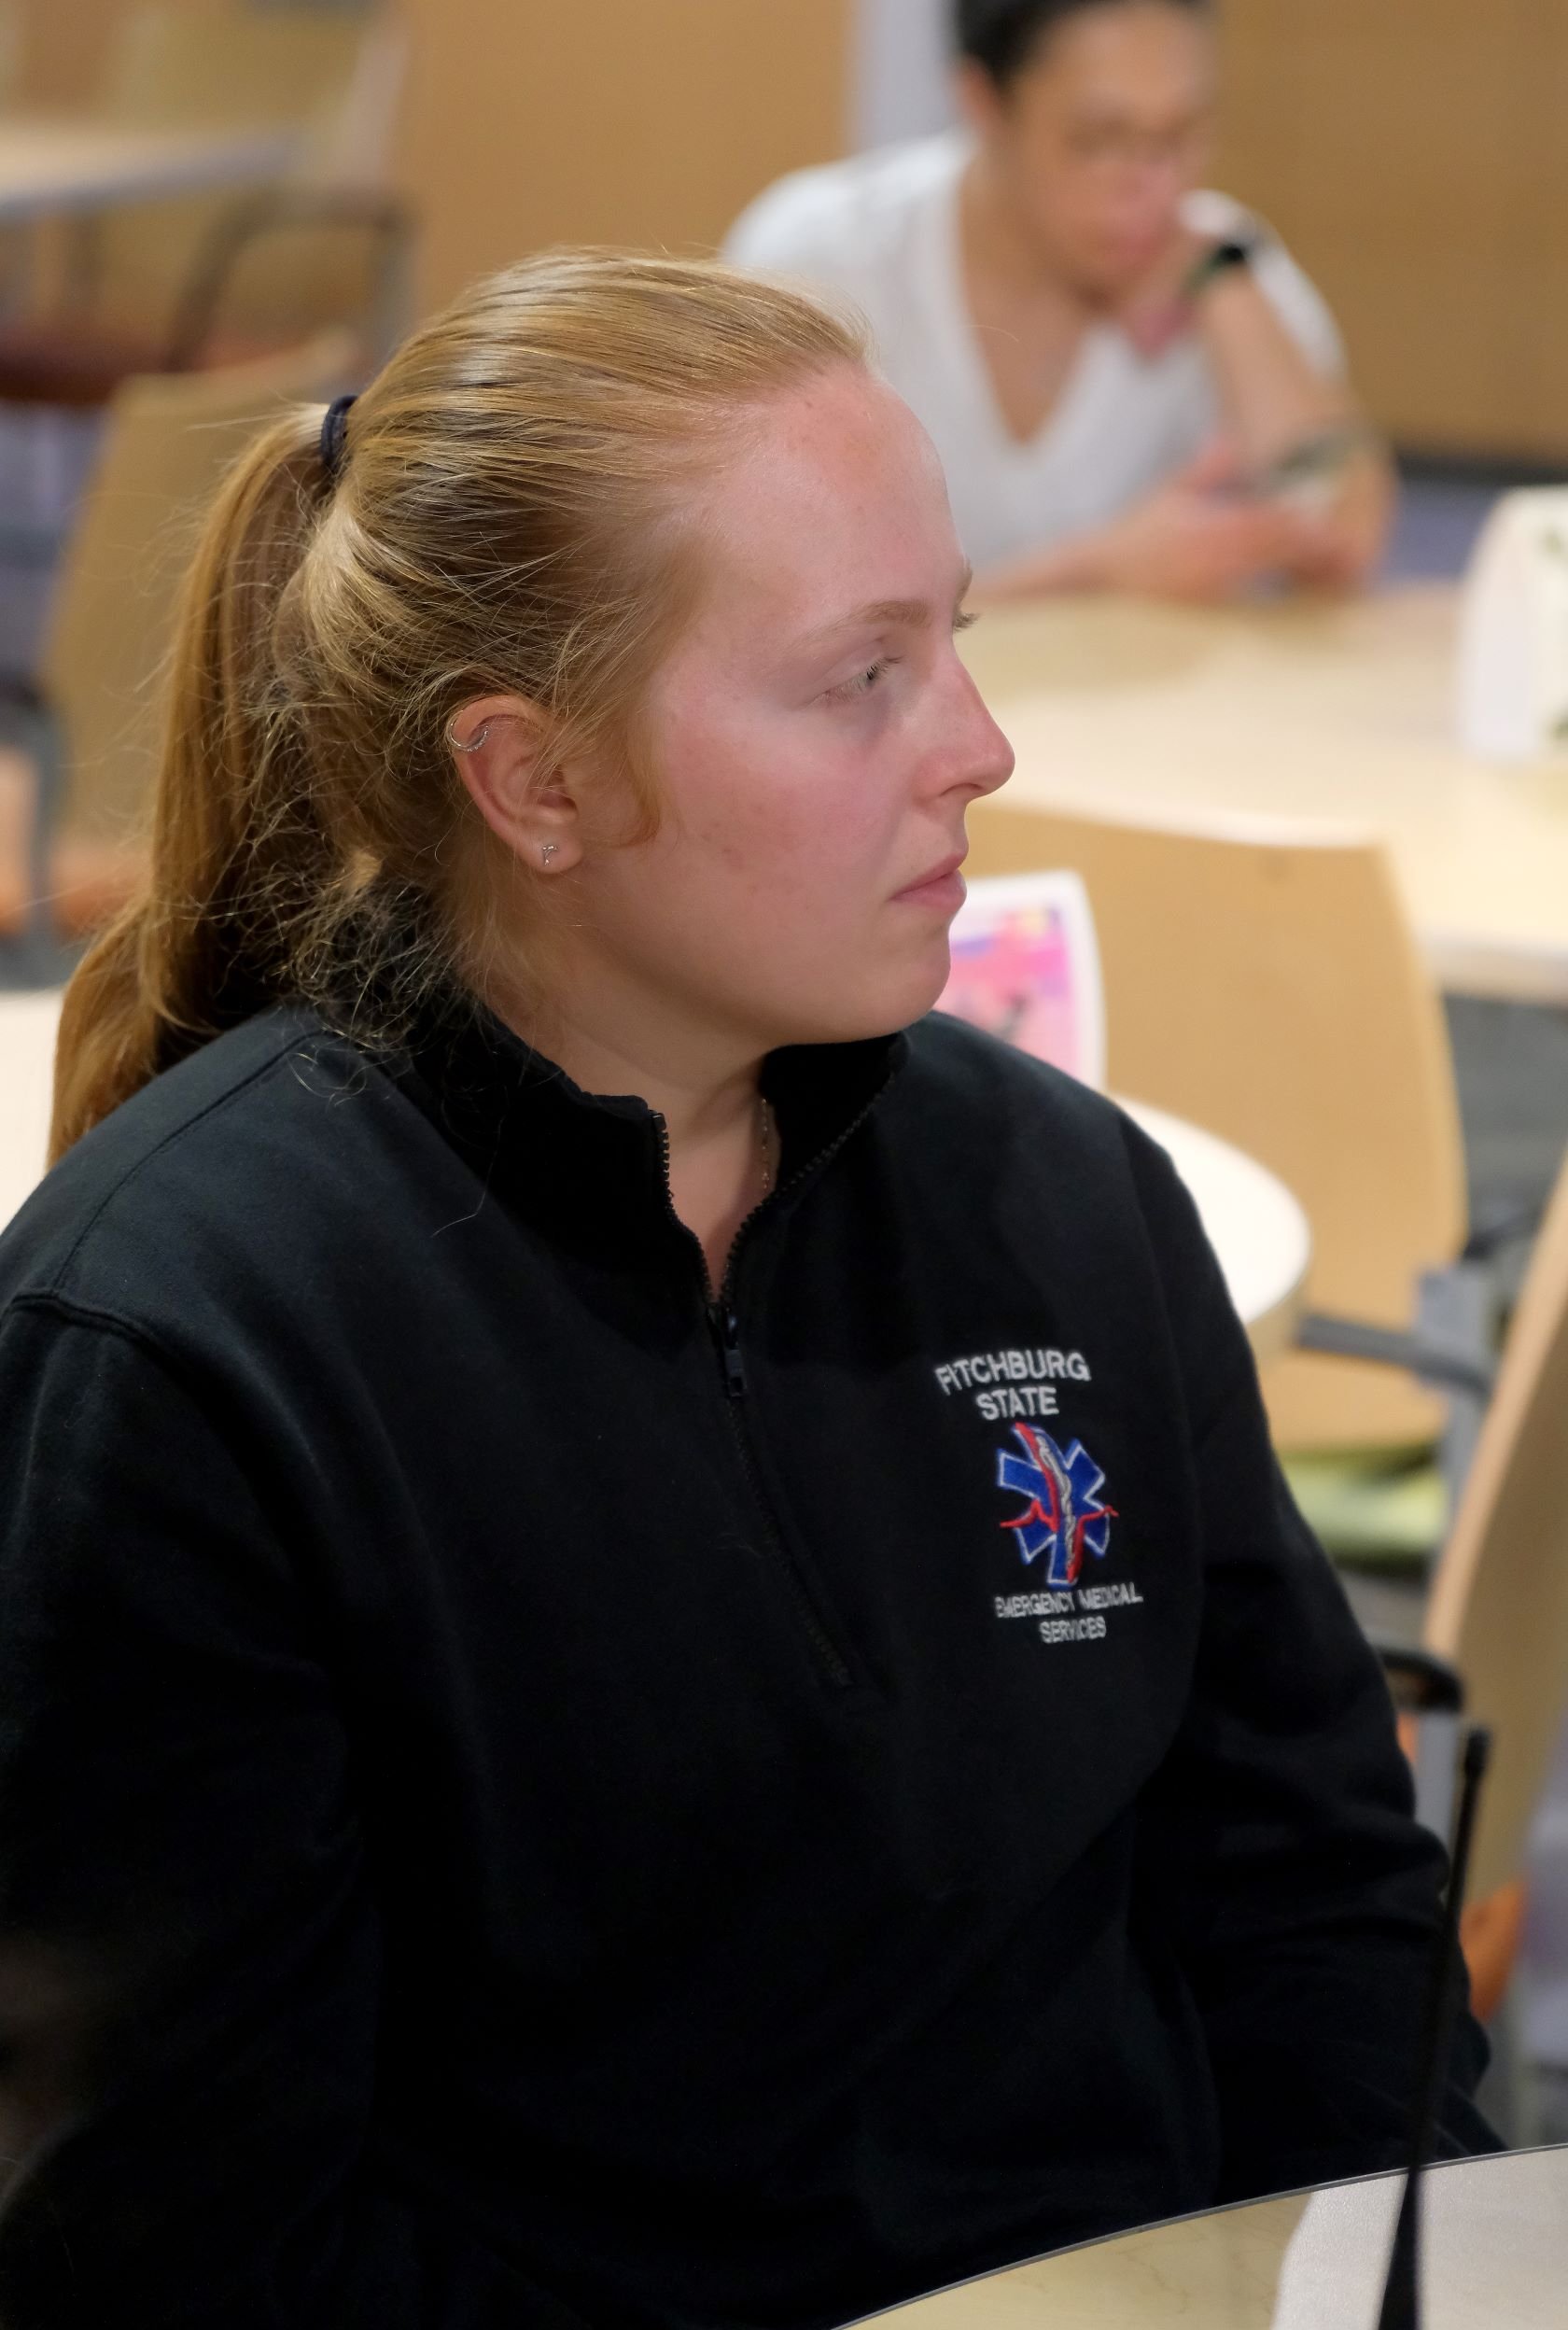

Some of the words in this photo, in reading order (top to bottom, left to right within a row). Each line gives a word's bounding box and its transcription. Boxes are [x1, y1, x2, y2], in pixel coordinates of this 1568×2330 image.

[935, 1349, 1091, 1396] FITCHBURG
[975, 1386, 1059, 1420] STATE
[994, 1592, 1075, 1618] EMERGENCY
[1077, 1581, 1144, 1610] MEDICAL
[1040, 1616, 1107, 1643] SERVICES
